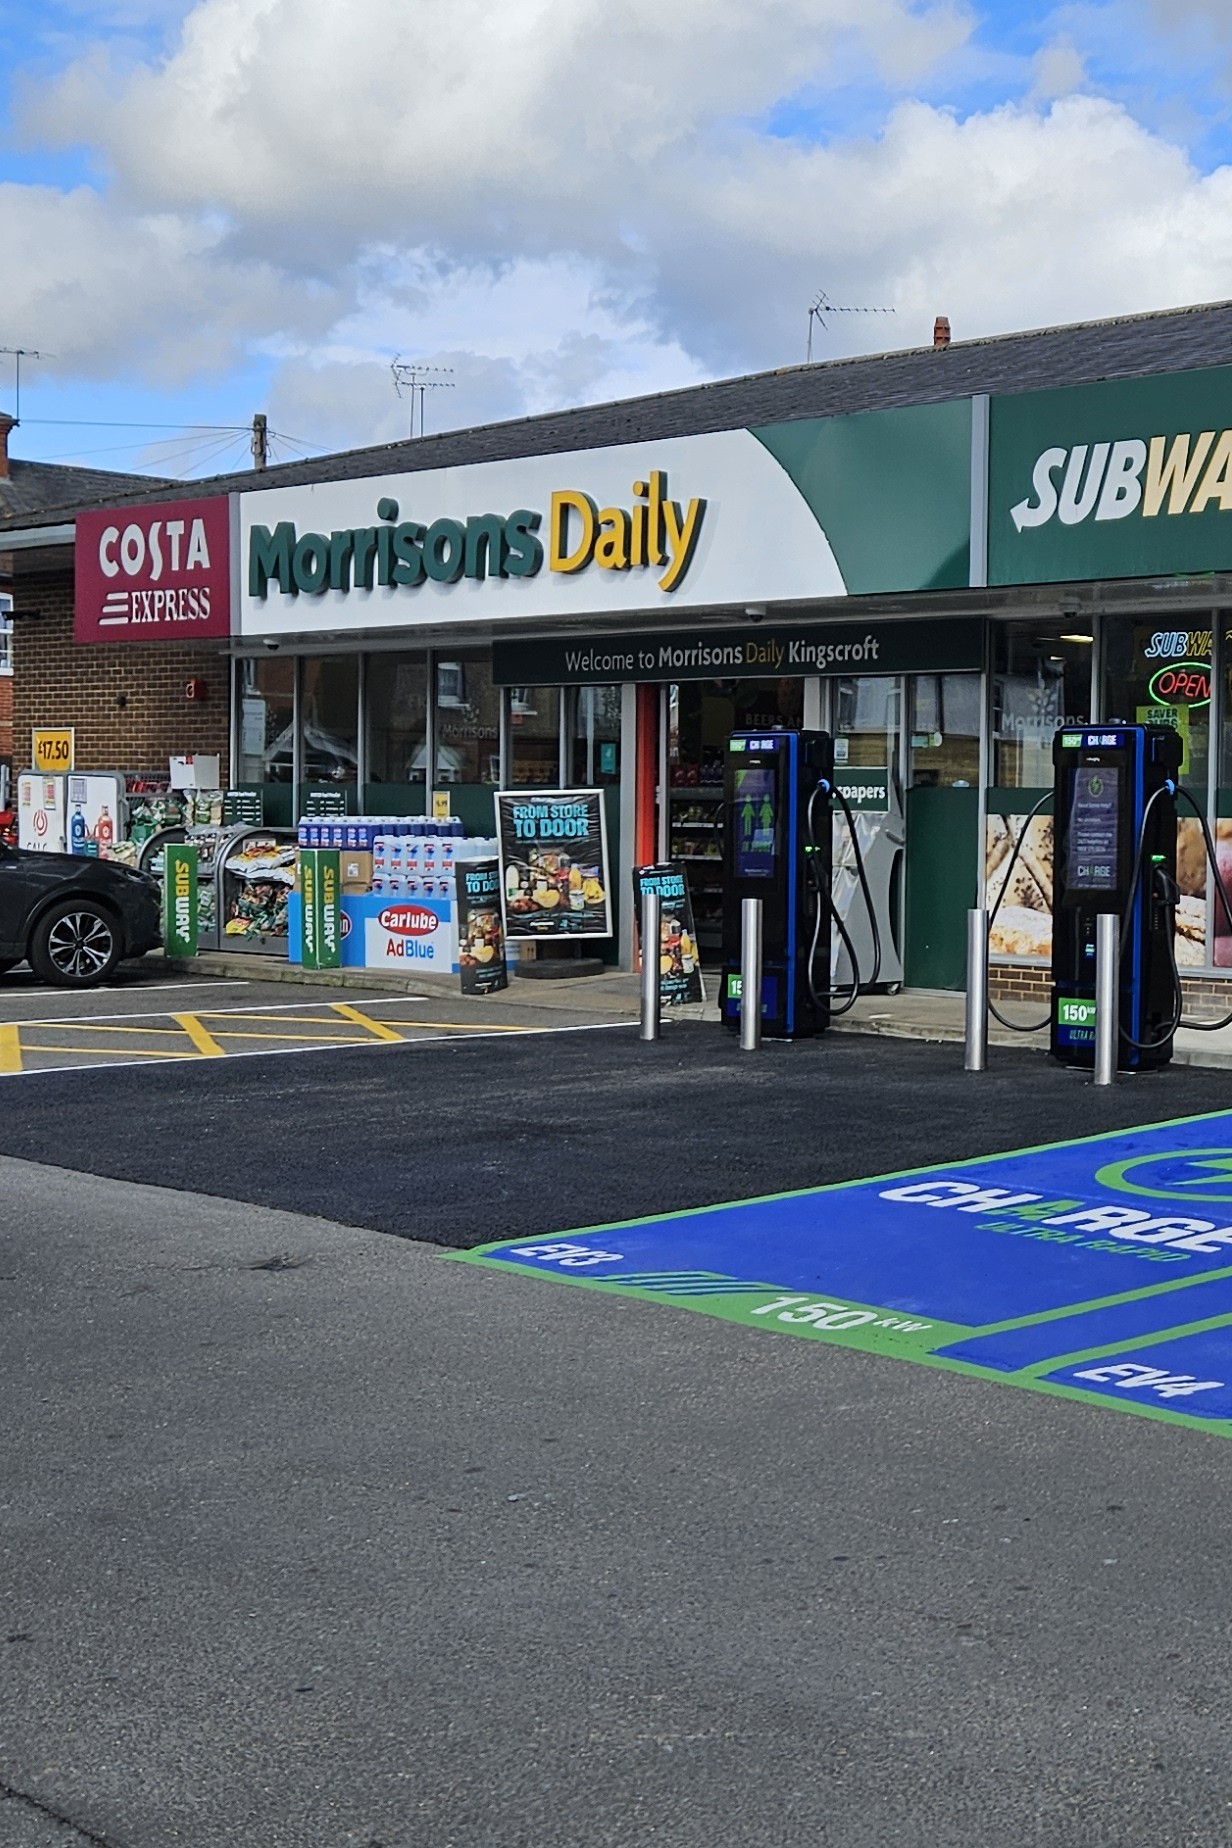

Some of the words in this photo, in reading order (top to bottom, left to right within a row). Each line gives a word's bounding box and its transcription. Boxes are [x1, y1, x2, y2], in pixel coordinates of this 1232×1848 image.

[249, 498, 543, 597] Morrisons
[550, 470, 707, 592] Daily
[100, 518, 210, 581] COSTA
[131, 587, 210, 622] EXPRESS
[565, 650, 634, 671] Welcome
[638, 651, 655, 668] to
[659, 641, 743, 668] Morrisons
[746, 639, 785, 668] Daily
[789, 636, 879, 668] Kingscroft
[1144, 631, 1212, 658] SUBWA
[1159, 672, 1212, 698] OPEN
[1002, 713, 1084, 730] Morrisons
[1147, 708, 1178, 718] SAVER
[38, 740, 69, 760] £17.50
[513, 805, 548, 818] FROM
[550, 804, 588, 818] STORE
[513, 819, 536, 837] TO
[540, 818, 589, 837] DOOR
[1077, 865, 1111, 877] CHARGE
[466, 881, 480, 893] TO
[656, 884, 685, 897] DOOR
[175, 859, 190, 943] SUBWAY
[304, 866, 313, 953] SUBWAY
[324, 866, 335, 953] SUBWAY
[381, 910, 437, 930] Carlube
[386, 938, 434, 959] AdBlue
[975, 1221, 1076, 1244] ULTRA
[1075, 1240, 1191, 1262] RAPID
[510, 1243, 624, 1267] EV3
[750, 1296, 880, 1331] 150
[1073, 1363, 1225, 1399] EV4
